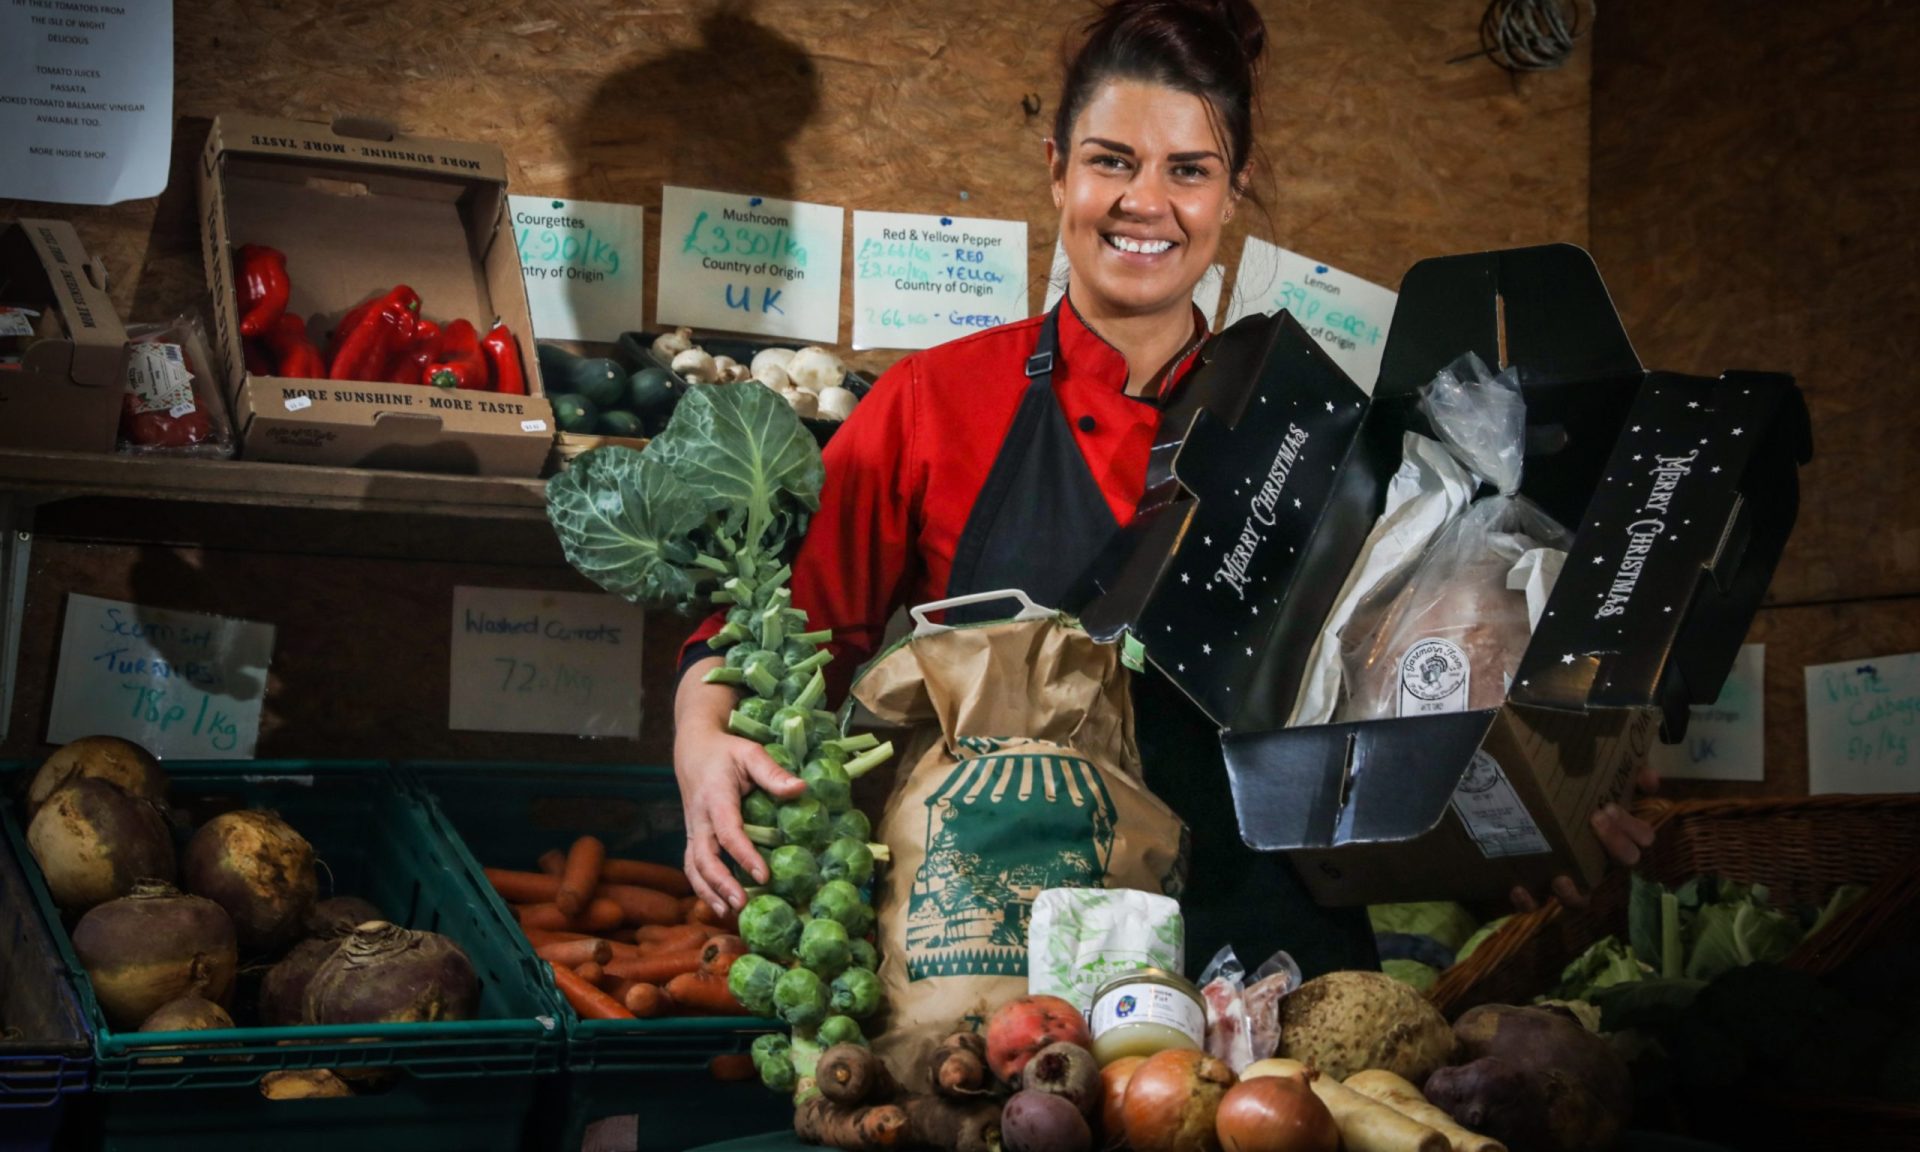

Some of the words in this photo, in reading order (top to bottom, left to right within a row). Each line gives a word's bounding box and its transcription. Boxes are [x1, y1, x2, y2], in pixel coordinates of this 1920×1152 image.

[29, 0, 51, 9] THESE
[54, 2, 99, 13] TOMATOES
[100, 6, 125, 15] FROM
[31, 16, 46, 25] THE
[49, 17, 63, 27] ISLE
[65, 18, 76, 28] OF
[78, 19, 105, 30] WIGHT
[47, 34, 89, 45] DELICIOUS
[35, 66, 72, 76] TOMATO
[50, 84, 86, 94] PASSATA
[0, 96, 27, 105] MOKED
[29, 98, 64, 108] TOMATO
[66, 101, 107, 111] BALSAMIC
[109, 104, 145, 112] VINEGAR
[36, 115, 79, 125] AVAILABLE
[251, 135, 297, 150] TASTE
[303, 140, 346, 153] MORE
[30, 147, 54, 156] MORE
[56, 148, 82, 158] INSIDE
[361, 146, 434, 164] SUNSHINE
[441, 156, 480, 170] MORE
[516, 211, 585, 230] Courgettes
[722, 207, 789, 228] Mushroom
[882, 229, 907, 241] Red
[909, 230, 919, 241] &
[921, 231, 960, 244] Yellow
[962, 233, 1003, 247] Pepper
[955, 248, 984, 263] RED
[550, 266, 563, 278] of
[566, 267, 604, 282] Origin
[702, 256, 751, 275] Country
[754, 262, 767, 275] of
[769, 265, 805, 281] Origin
[894, 278, 942, 298] Country
[944, 280, 957, 293] of
[959, 281, 994, 297] Origin
[1304, 274, 1341, 296] Lemon
[948, 310, 1007, 327] GREEN
[1311, 326, 1324, 338] of
[1324, 330, 1357, 352] Origin
[281, 388, 328, 402] MORE
[333, 390, 413, 406] SUNSHINE
[429, 397, 474, 411] MORE
[477, 401, 525, 416] TASTE
[465, 608, 539, 634] Washed
